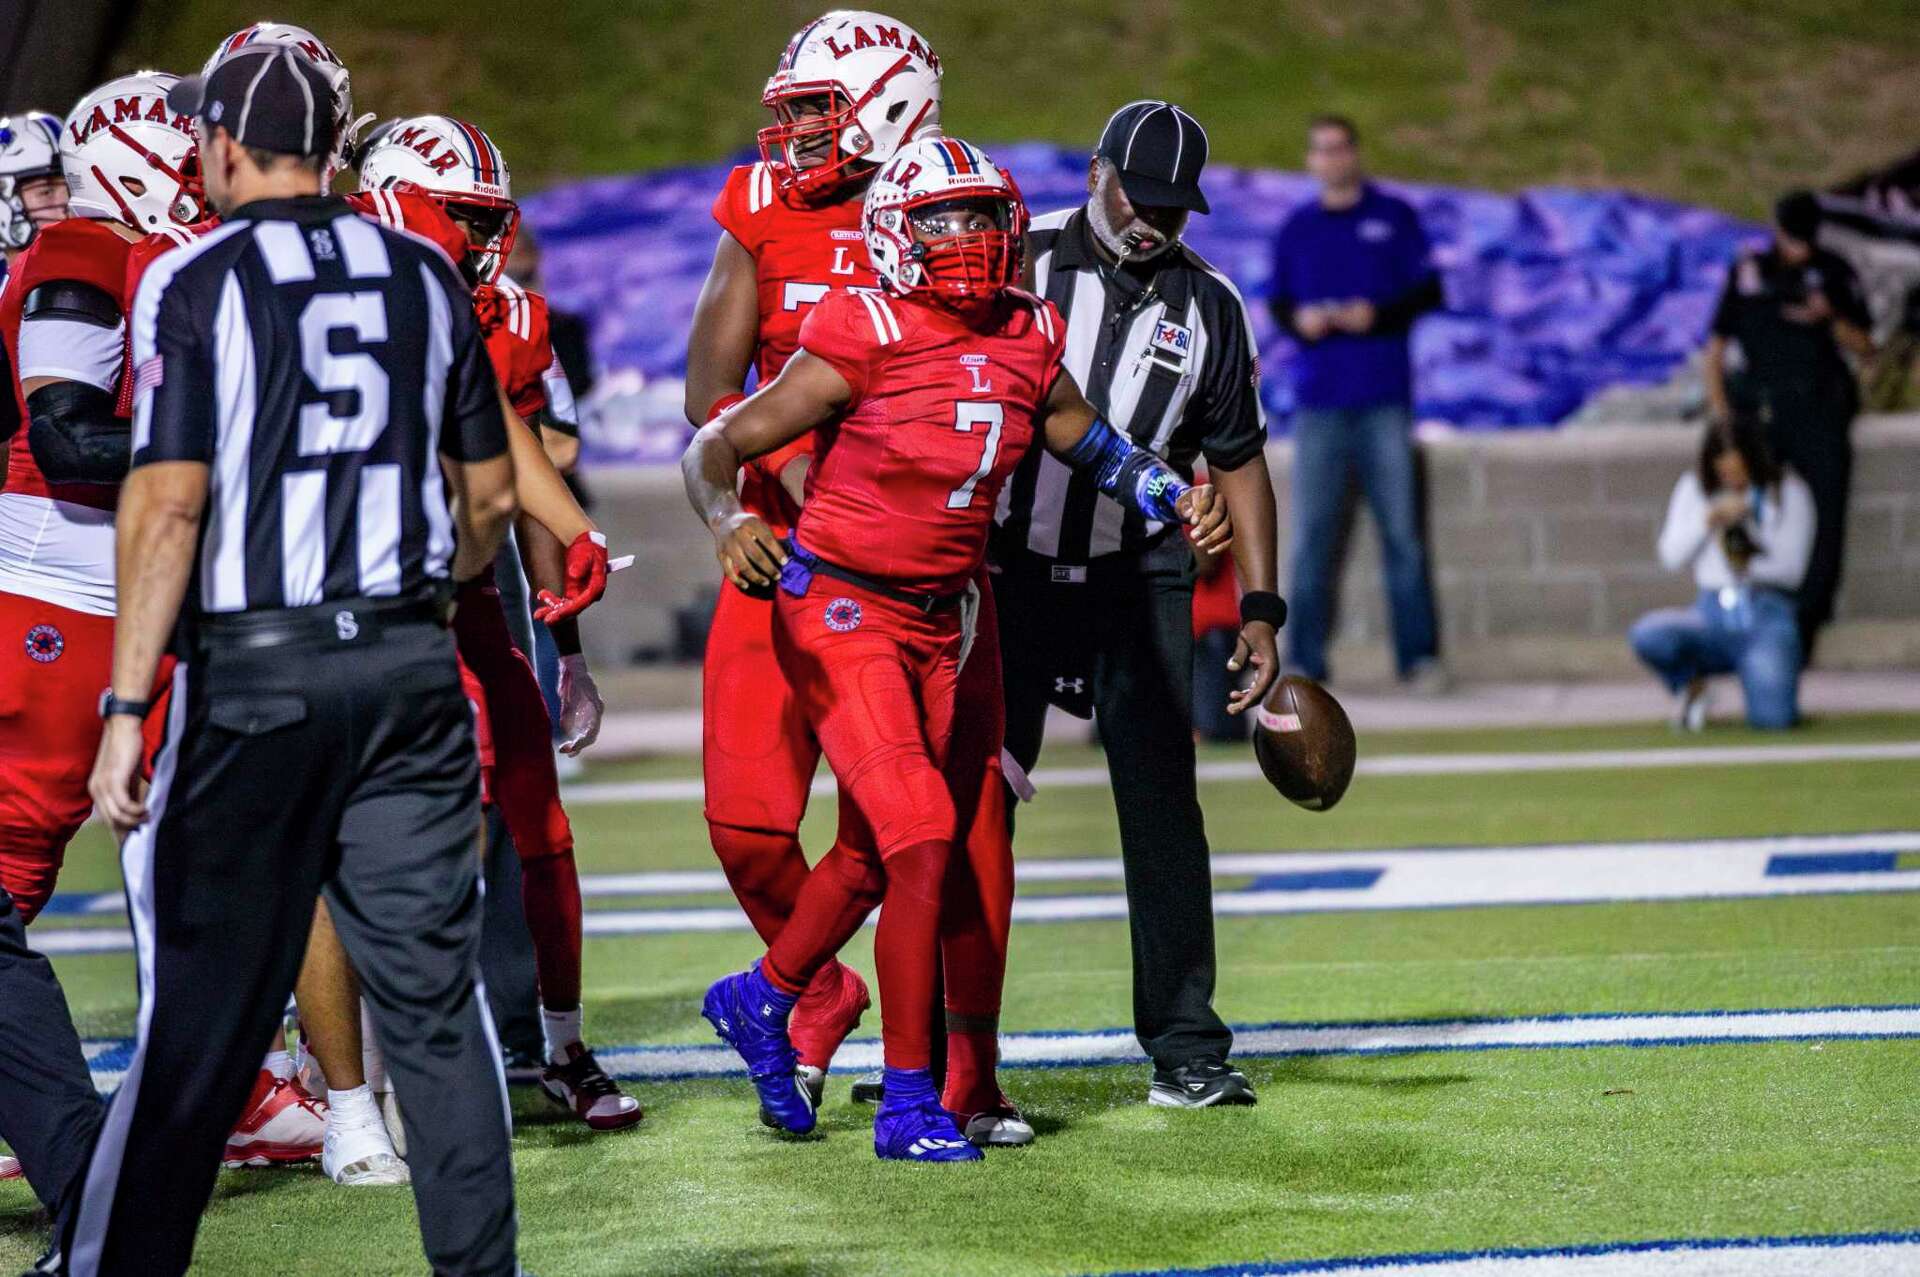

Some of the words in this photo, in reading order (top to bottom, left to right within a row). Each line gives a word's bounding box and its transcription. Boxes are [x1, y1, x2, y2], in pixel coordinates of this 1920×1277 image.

[831, 247, 854, 275] L
[299, 291, 389, 458] S
[966, 366, 991, 393] L
[945, 400, 1004, 509] 7
